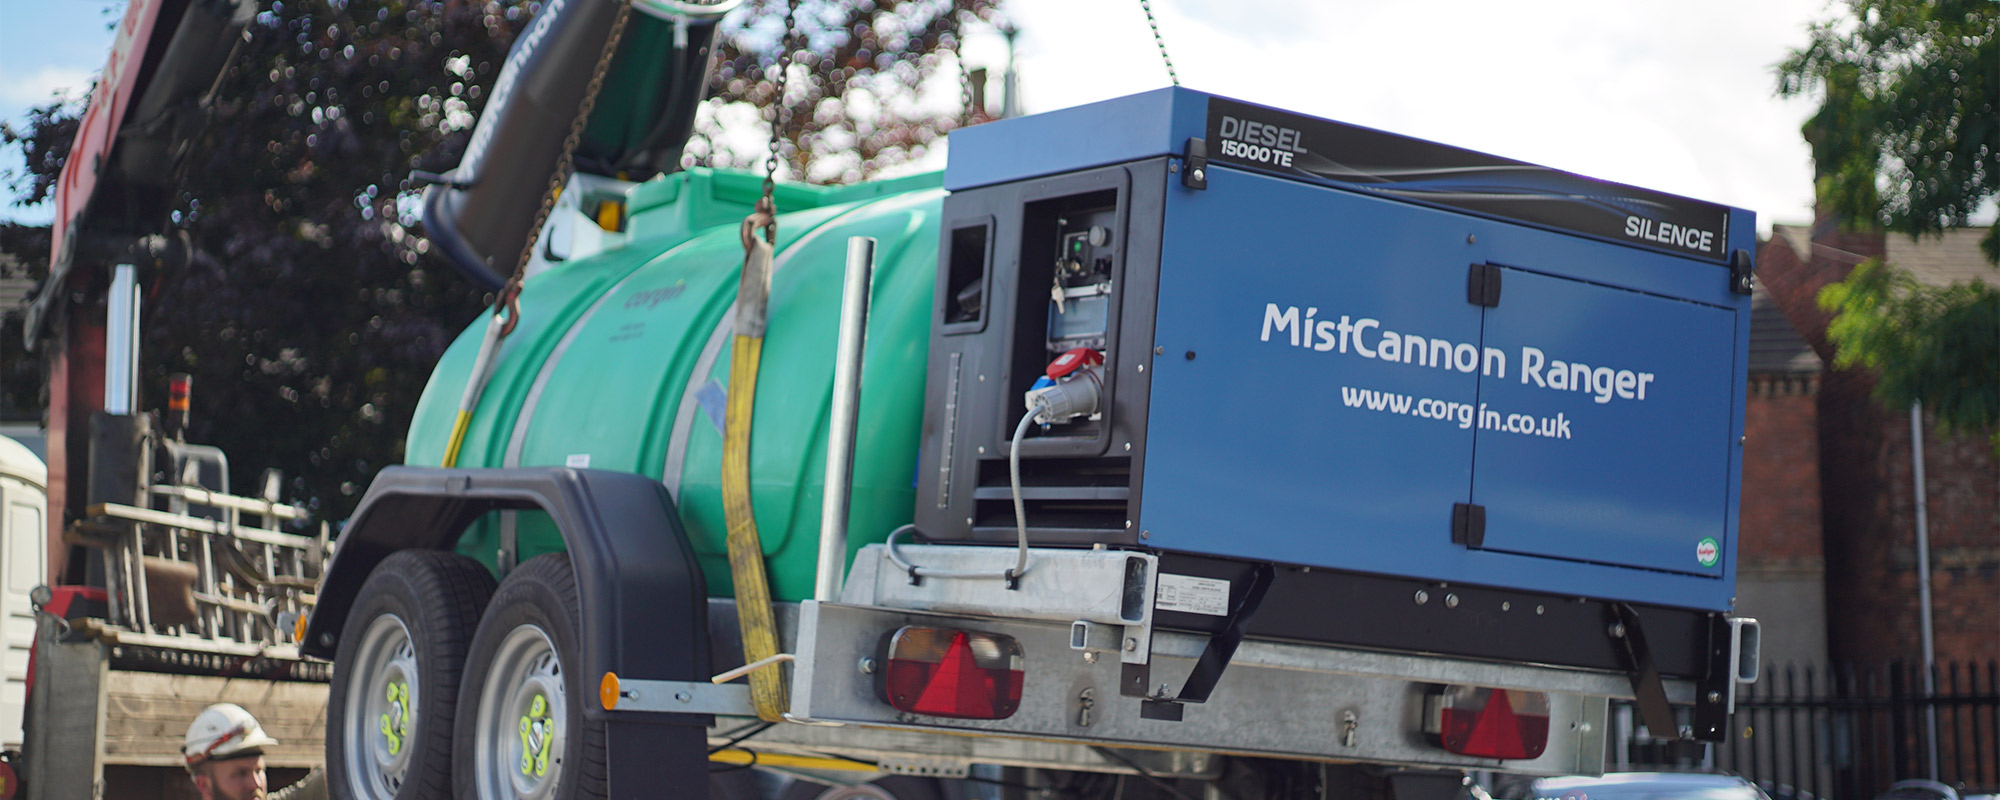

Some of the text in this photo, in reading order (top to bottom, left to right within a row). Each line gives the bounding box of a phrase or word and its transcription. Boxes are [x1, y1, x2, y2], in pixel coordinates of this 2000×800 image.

[1219, 116, 1307, 153] DIESEL
[1220, 139, 1294, 168] 15000 TE
[1625, 215, 1714, 252] SILENCE
[1521, 347, 1655, 404] Ranger
[1341, 386, 1571, 440] www.corgin.co.uk
